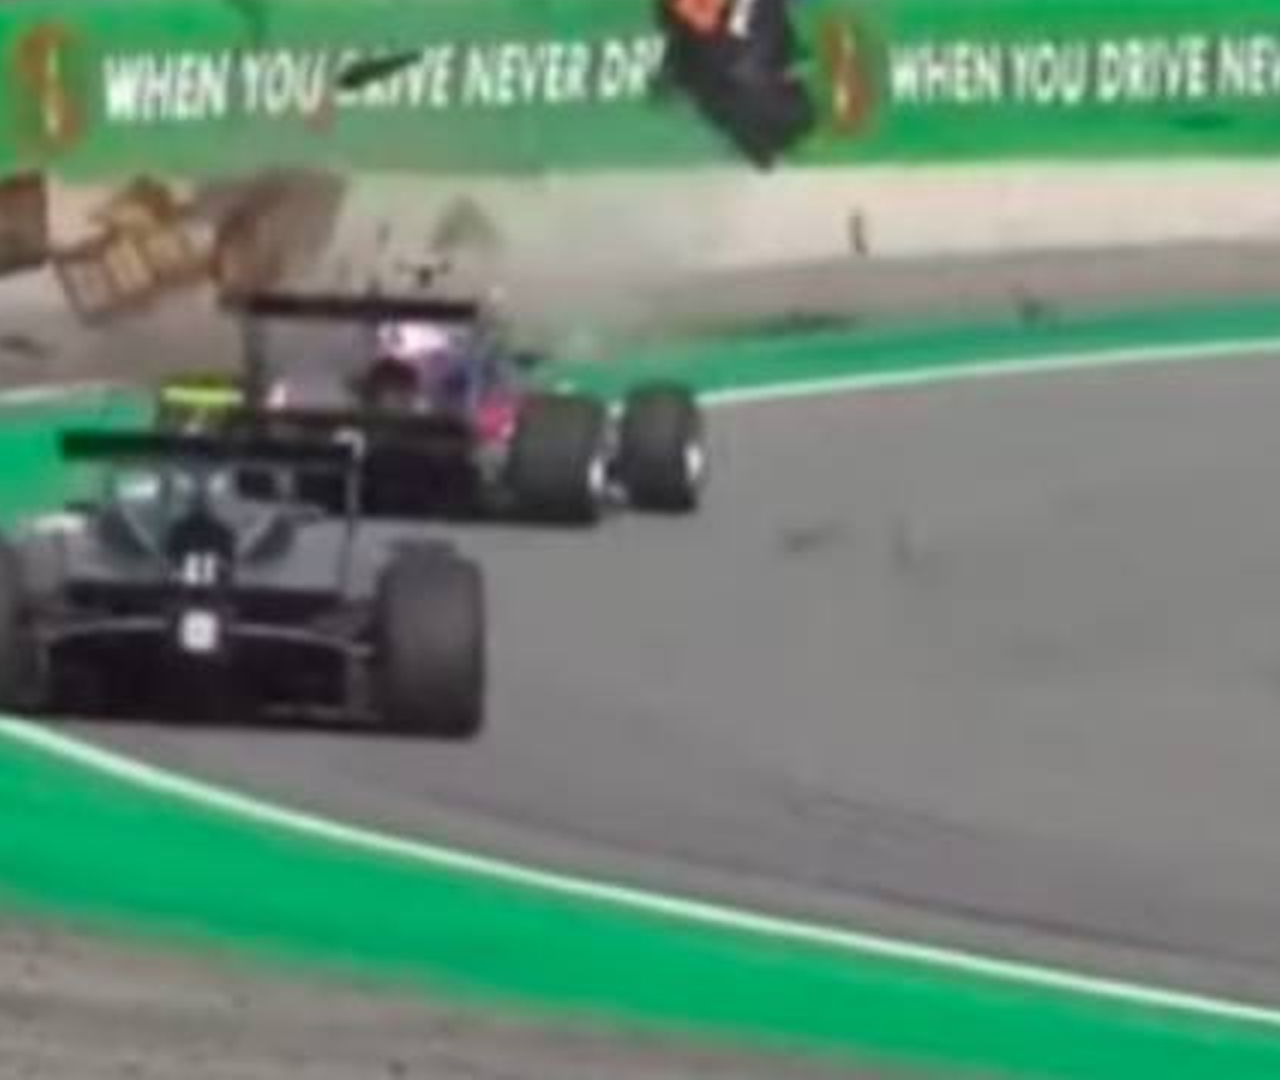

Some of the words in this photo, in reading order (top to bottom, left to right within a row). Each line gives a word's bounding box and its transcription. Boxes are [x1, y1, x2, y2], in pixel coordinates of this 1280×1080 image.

[103, 53, 229, 119] WHEN
[241, 48, 326, 115] YOU
[461, 39, 591, 106] NEVER
[888, 42, 1001, 104] WHEN
[1012, 39, 1088, 101] YOU
[1097, 34, 1209, 97] DRIVE
